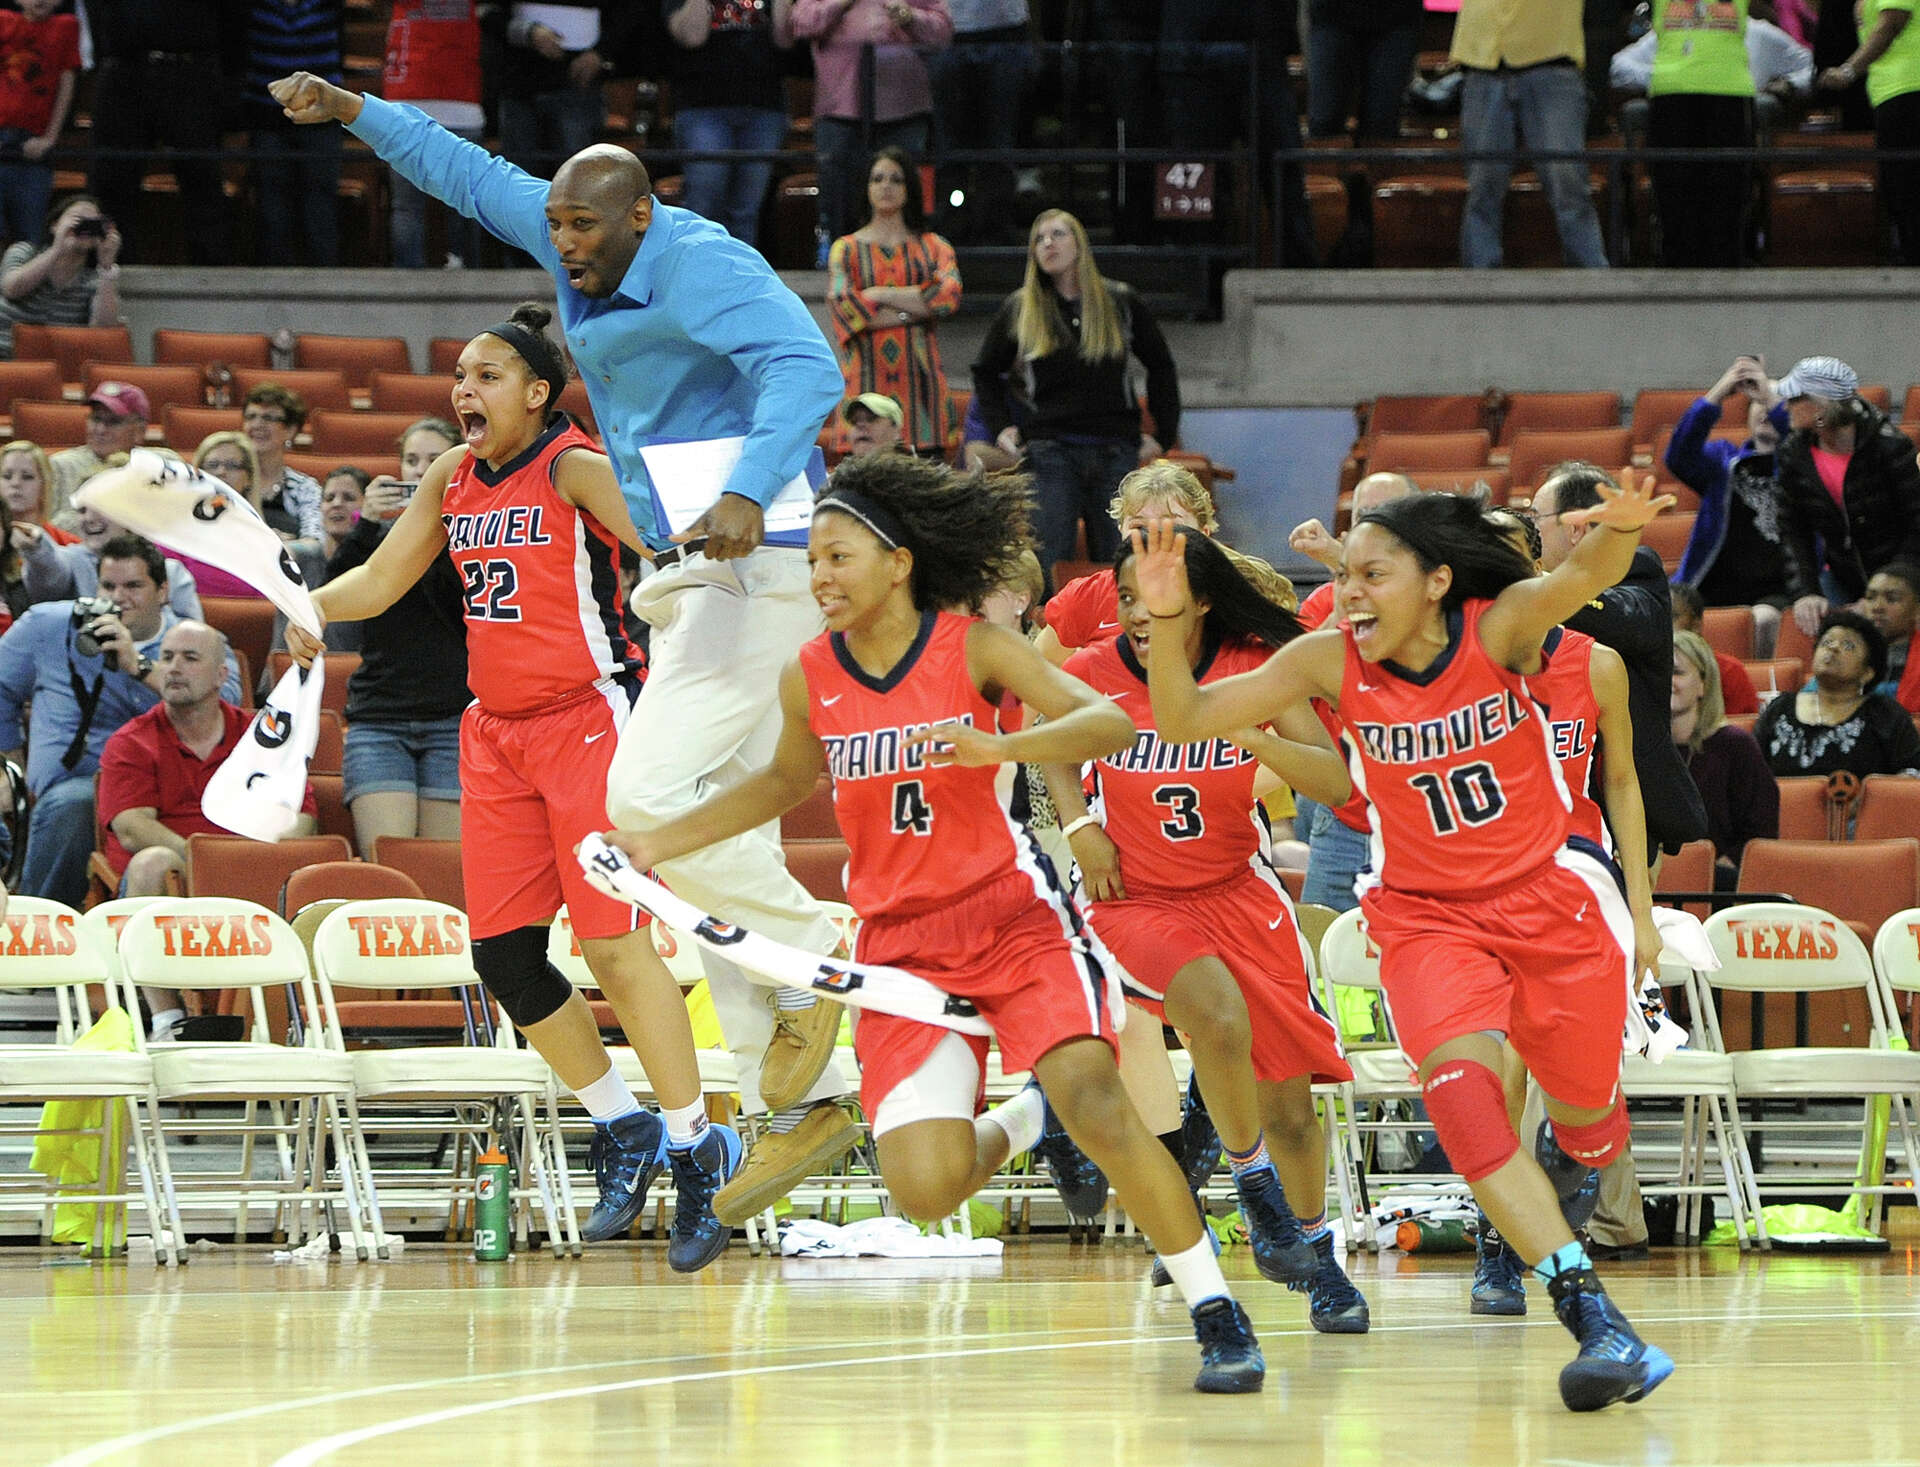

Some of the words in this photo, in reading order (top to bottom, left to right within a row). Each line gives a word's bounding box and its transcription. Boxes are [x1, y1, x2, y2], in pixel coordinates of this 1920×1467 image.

[1165, 163, 1205, 189] 47
[461, 558, 522, 622] 22
[891, 779, 934, 837] 4
[1152, 783, 1206, 842] 3
[1407, 760, 1508, 837] 10
[0, 914, 77, 957] XAS
[154, 914, 272, 957] TEXAS
[348, 914, 464, 957] TEXAS
[1727, 920, 1839, 960] TEXAS
[476, 1173, 495, 1200] G
